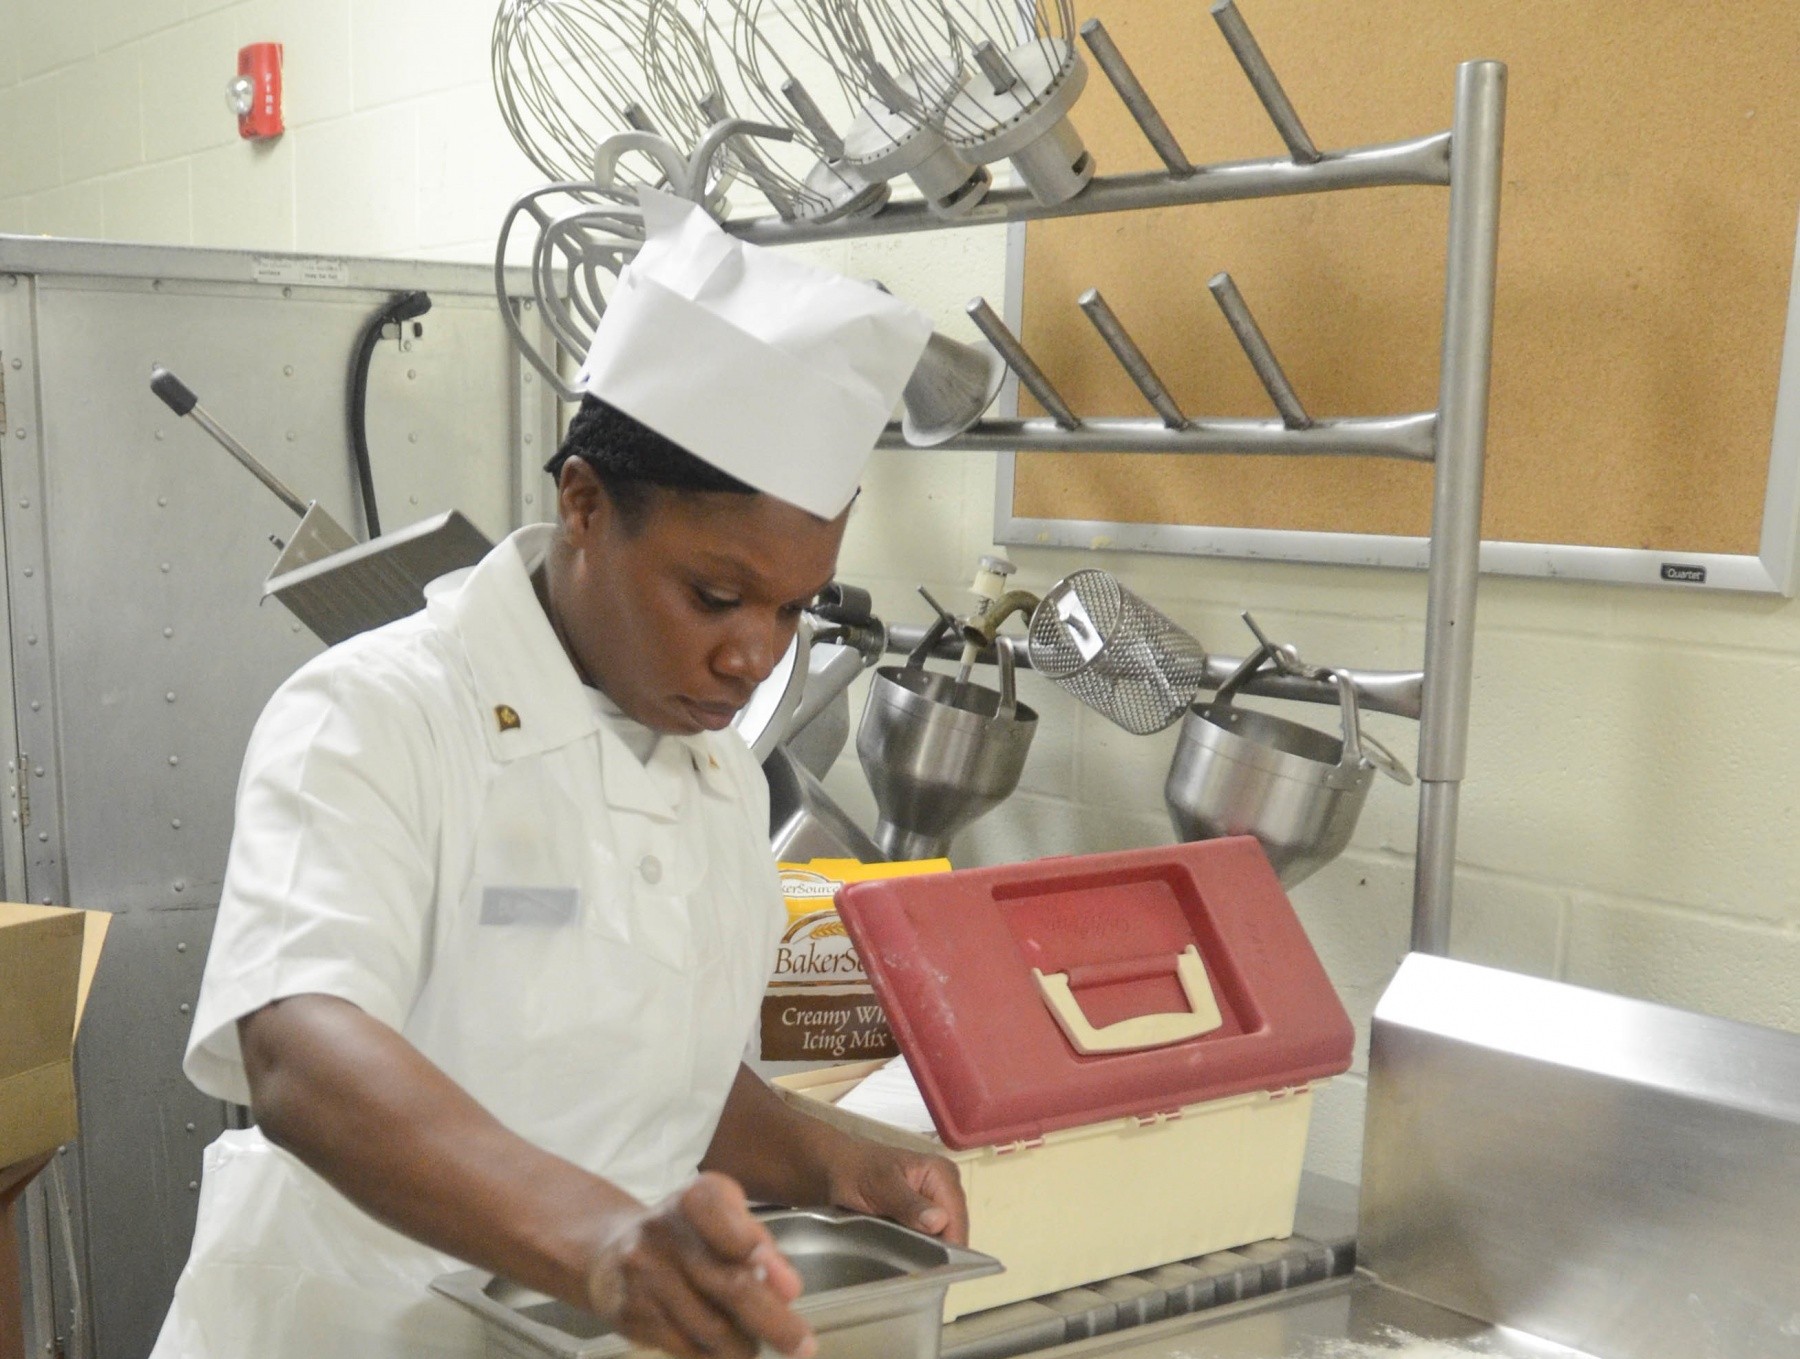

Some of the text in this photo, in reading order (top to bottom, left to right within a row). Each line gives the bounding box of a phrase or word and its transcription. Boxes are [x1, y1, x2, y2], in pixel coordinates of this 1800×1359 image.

[781, 1007, 851, 1032] Creamy
[802, 1027, 887, 1056] Icing Mix
